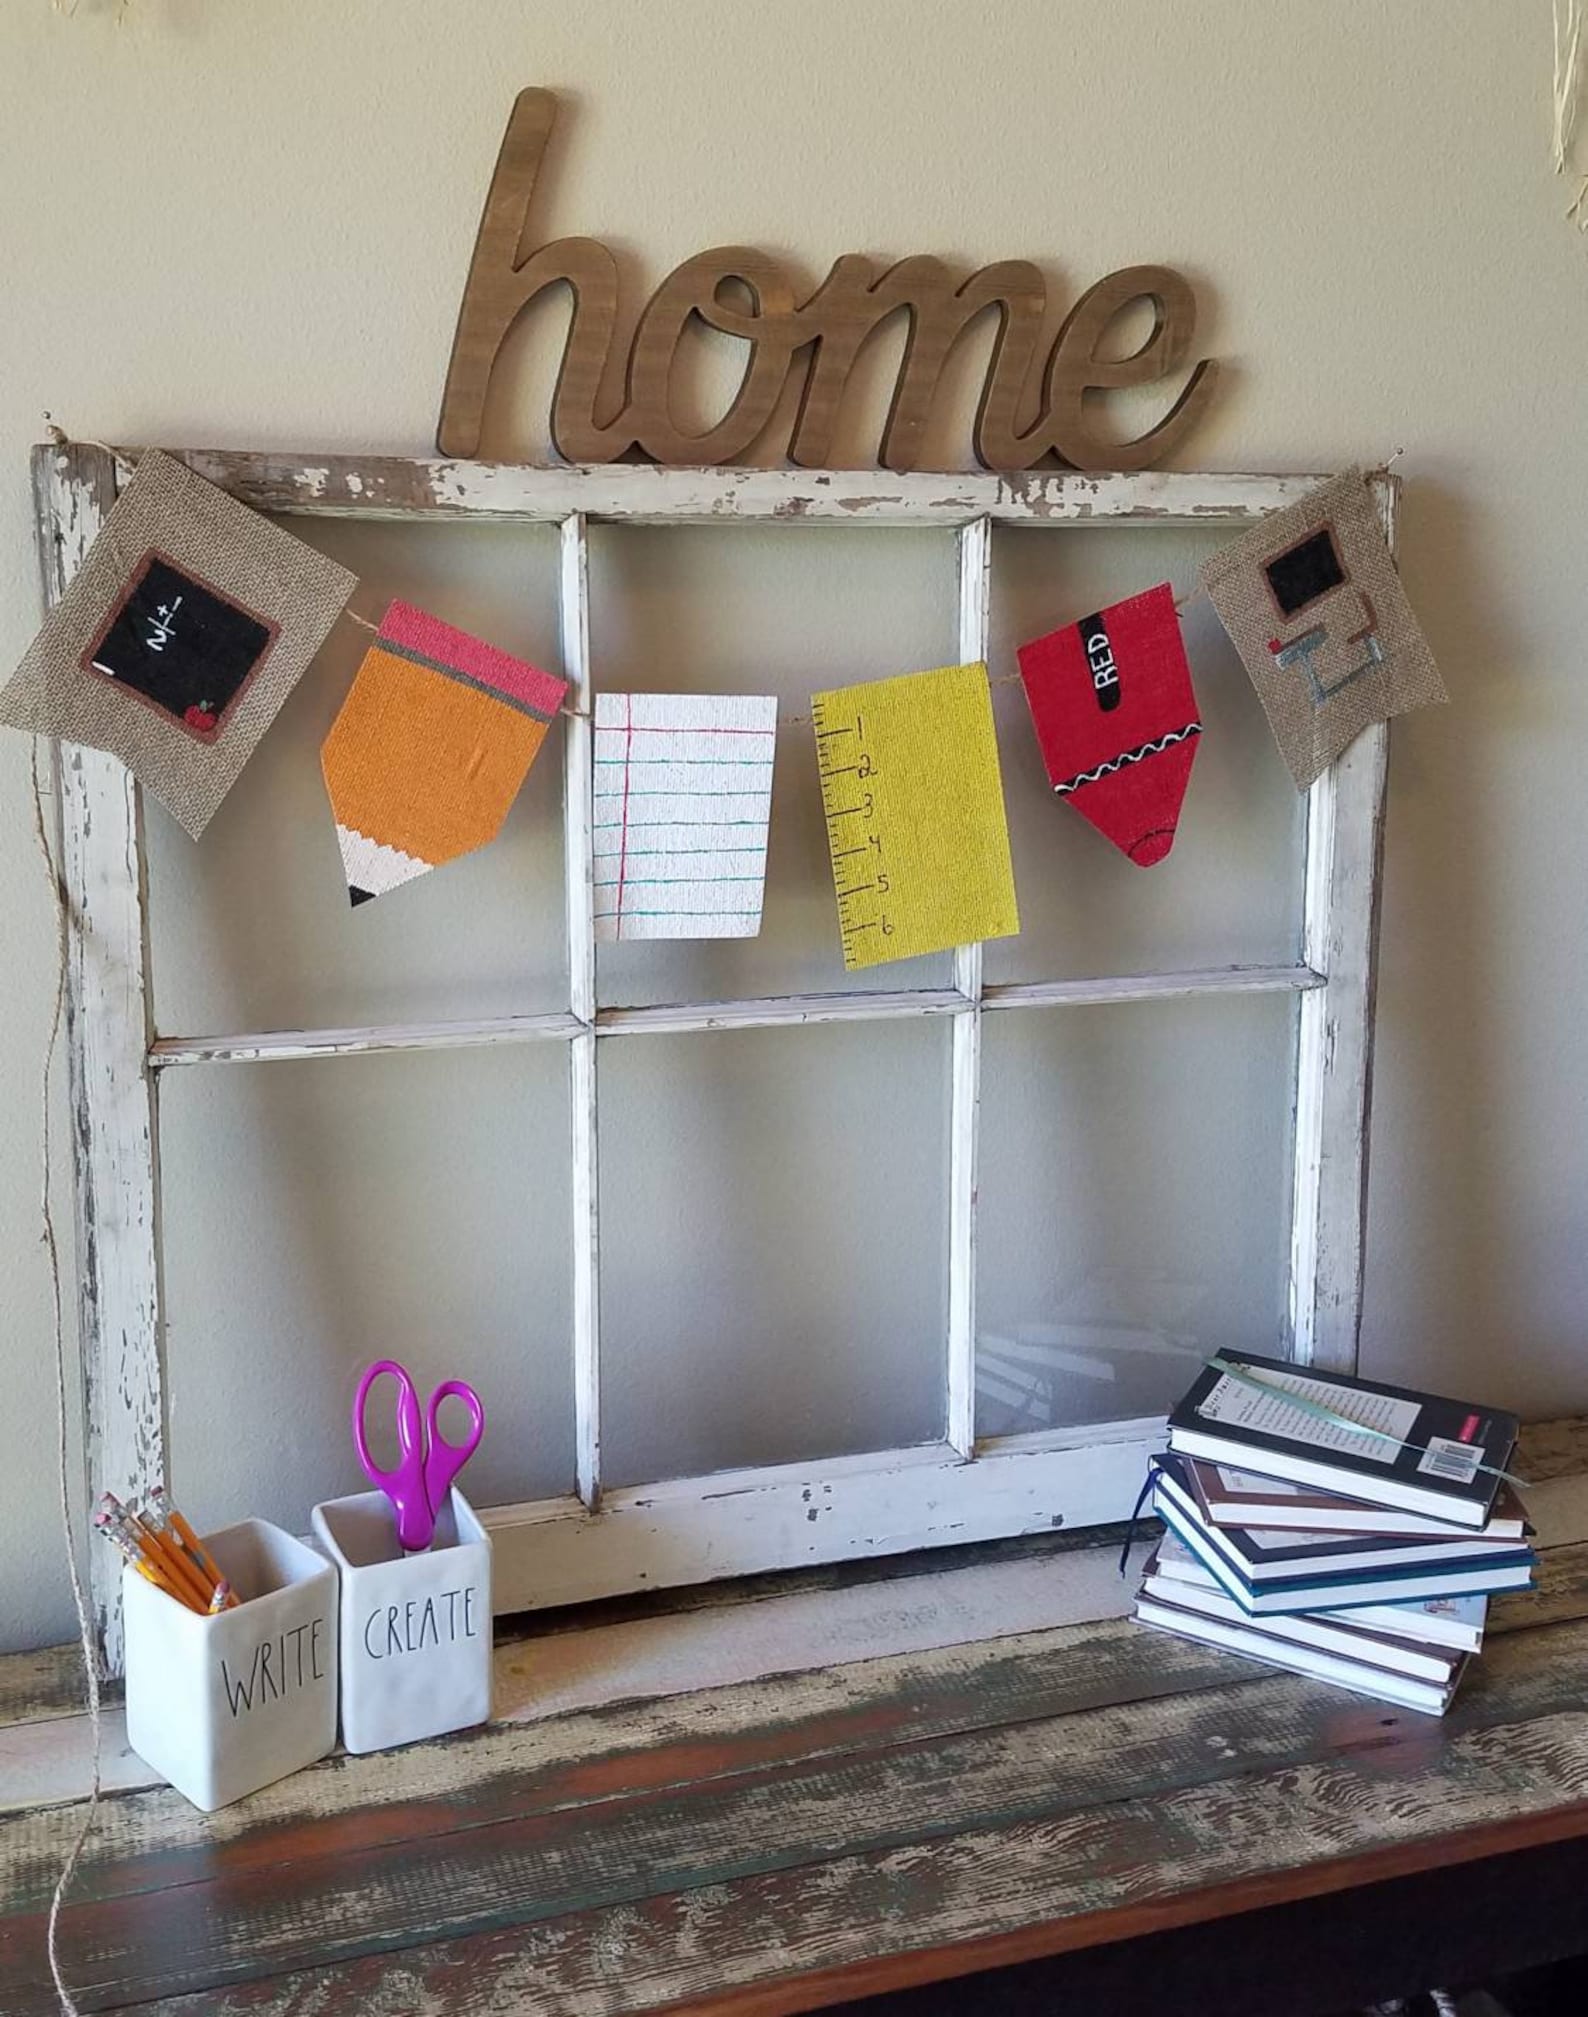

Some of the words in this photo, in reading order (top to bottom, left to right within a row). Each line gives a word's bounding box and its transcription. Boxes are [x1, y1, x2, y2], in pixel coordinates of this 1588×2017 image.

[434, 86, 1220, 472] home
[1087, 633, 1119, 690] RED
[856, 715, 863, 741] 1
[858, 754, 878, 778] 2
[863, 793, 874, 818] 3
[868, 835, 882, 853] 4
[877, 874, 890, 894] 5
[881, 914, 895, 936] 6
[364, 1587, 476, 1659] CREATE
[221, 1618, 324, 1717] WRITE
